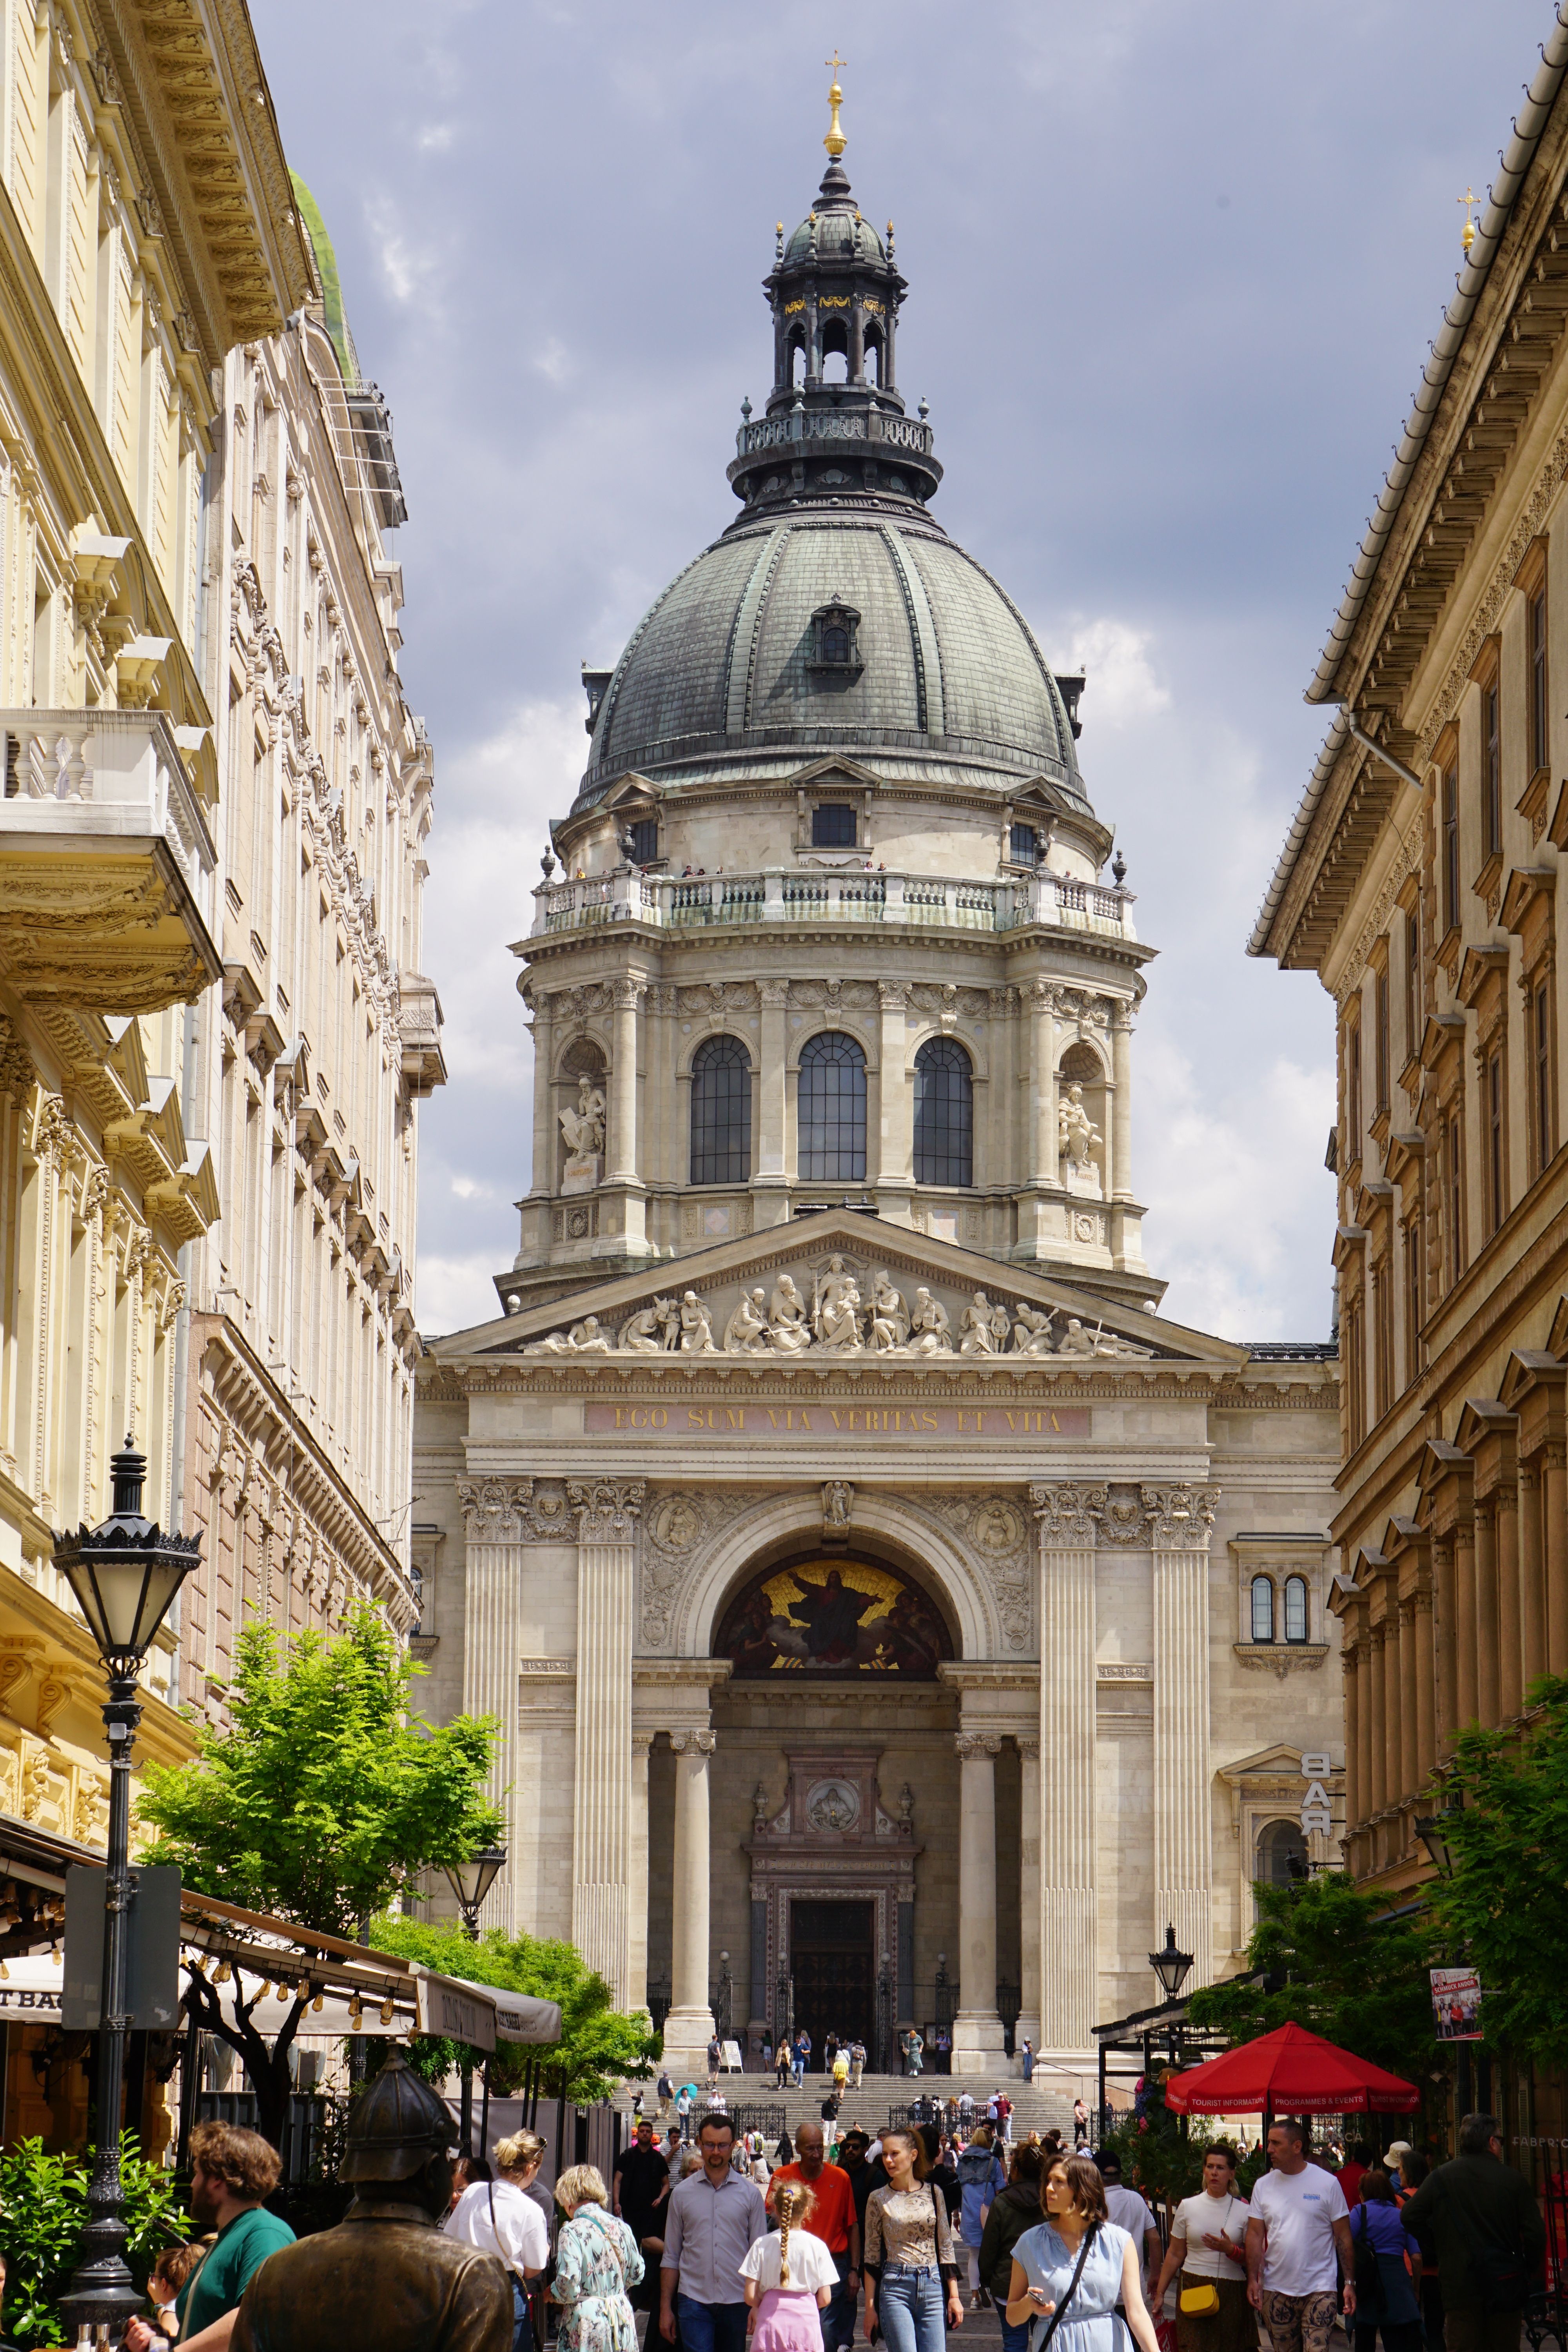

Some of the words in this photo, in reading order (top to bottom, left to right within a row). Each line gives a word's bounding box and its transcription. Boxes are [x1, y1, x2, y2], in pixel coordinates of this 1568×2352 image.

[614, 1408, 667, 1428] EGO
[688, 1409, 745, 1429] SUM
[766, 1410, 813, 1430] VIA
[829, 1410, 938, 1431] VERITAS
[956, 1411, 986, 1432] ET
[1004, 1412, 1062, 1432] VITA
[1434, 1983, 1457, 1993] SCHMUCK
[1457, 1980, 1474, 1989] ANDOR
[1192, 2098, 1221, 2107] TOURIST
[1223, 2097, 1264, 2106] INFORMATION
[1335, 2096, 1363, 2104] EVENTS
